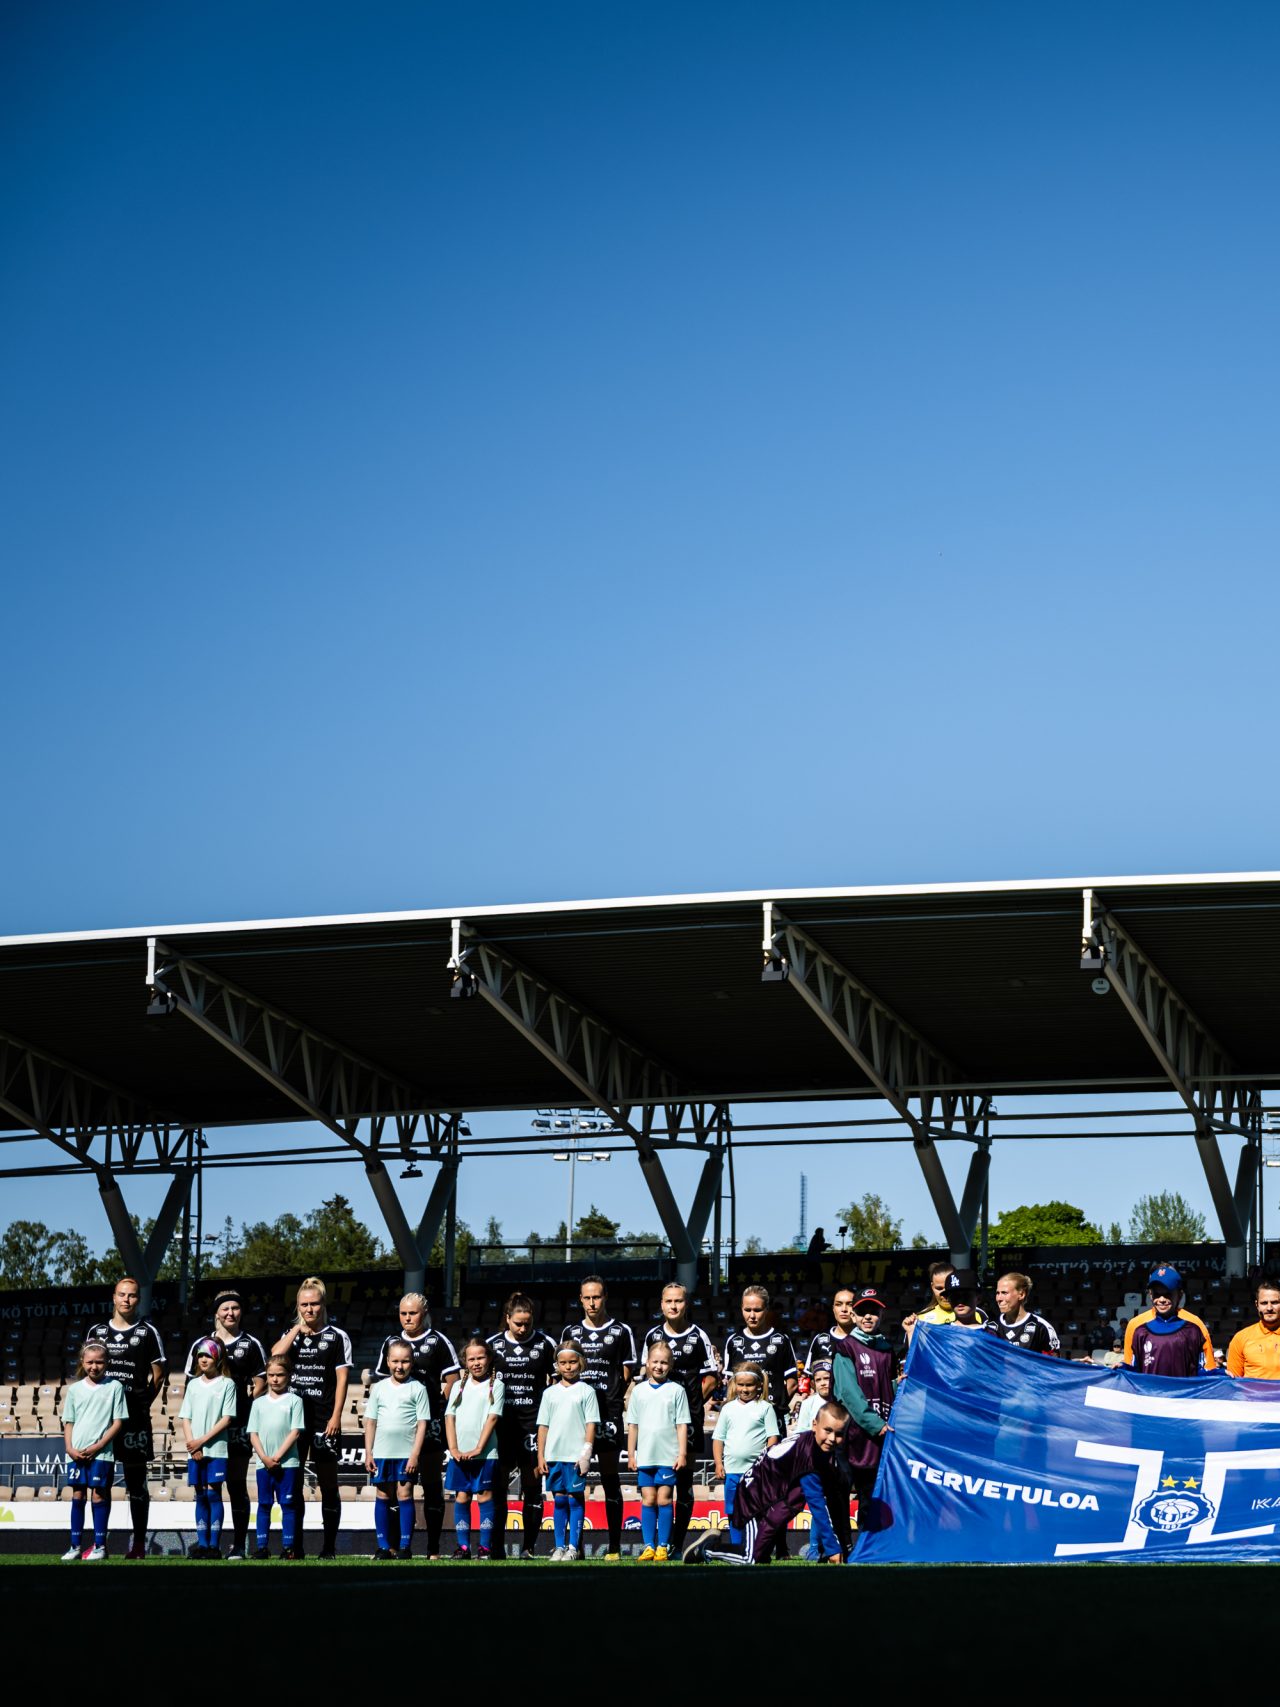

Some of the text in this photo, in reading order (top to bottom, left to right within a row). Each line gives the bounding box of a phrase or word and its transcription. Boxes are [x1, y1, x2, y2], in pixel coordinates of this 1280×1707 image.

[23, 1301, 69, 1319] TÖITÄ
[74, 1302, 95, 1317] TAI
[22, 1453, 68, 1476] ILMA
[69, 1467, 81, 1480] 29
[907, 1459, 1099, 1511] TERVETULOA
[1154, 1508, 1197, 1523] HJK
